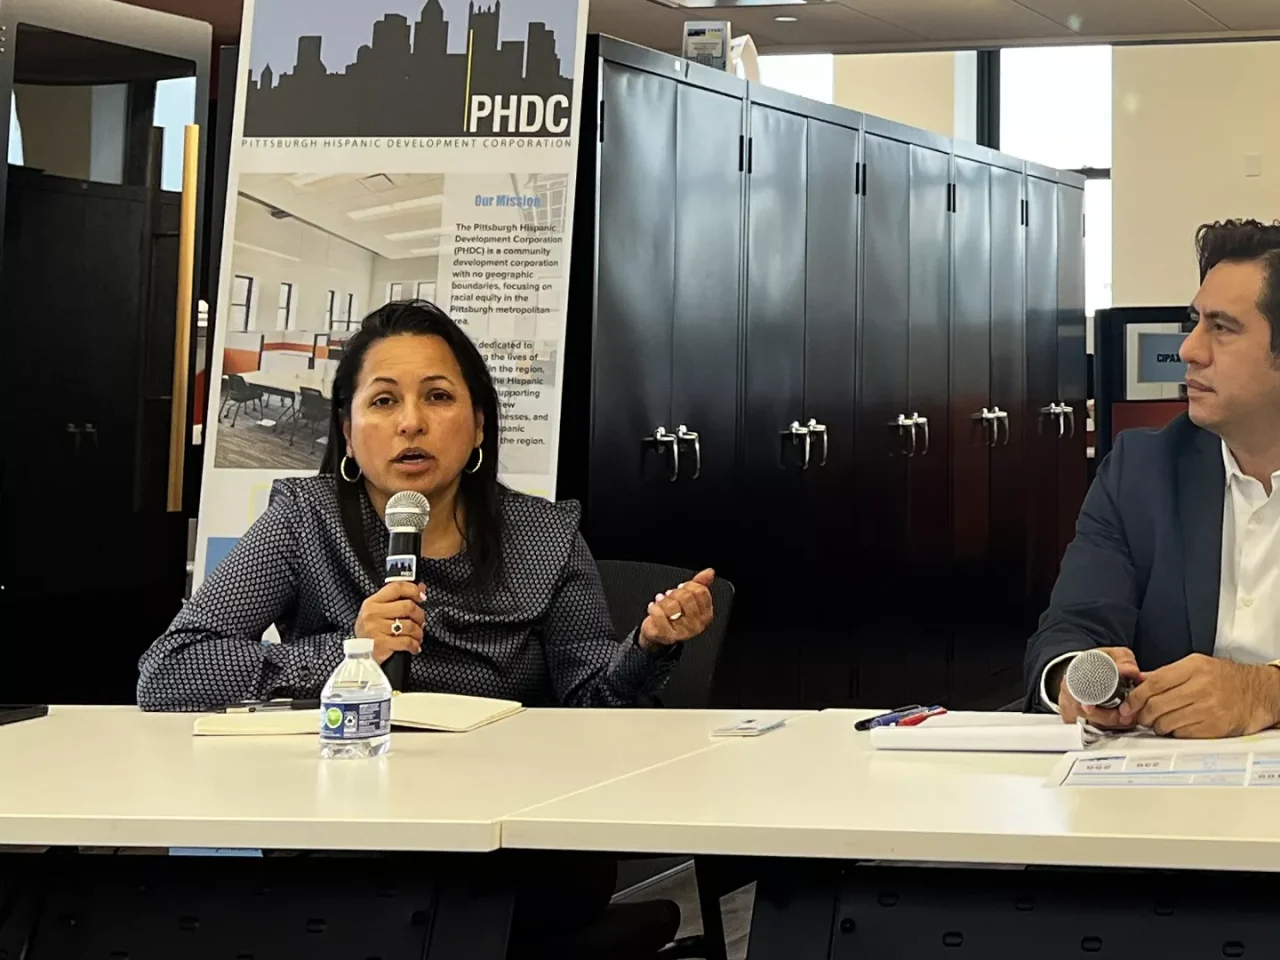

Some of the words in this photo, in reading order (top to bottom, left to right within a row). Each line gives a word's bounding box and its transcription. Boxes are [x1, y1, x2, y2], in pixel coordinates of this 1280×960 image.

[469, 94, 569, 134] PHDC
[241, 139, 318, 149] PITTSBURGH
[323, 139, 381, 149] HISPANIC
[386, 139, 477, 149] DEVELOPMENT
[483, 138, 572, 148] CORPORATION
[474, 194, 494, 207] Our
[496, 194, 541, 208] Mission
[456, 223, 472, 231] The
[473, 223, 518, 233] Pittsburgh
[520, 223, 556, 233] Hispanic
[455, 235, 511, 244] Development
[513, 235, 562, 244] Corporation
[454, 246, 485, 256] (PHDC)
[503, 247, 551, 257] community
[453, 259, 508, 268] development
[510, 259, 559, 268] corporation
[452, 270, 470, 278] with
[485, 270, 534, 280] geographic
[451, 282, 501, 291] boundaries,
[503, 282, 540, 292] focusing
[451, 293, 473, 301] racial
[475, 294, 501, 303] equity
[514, 294, 529, 302] the
[450, 305, 493, 314] Pittsburgh
[495, 305, 550, 314] metropolitan
[478, 341, 521, 349] dedicated
[499, 365, 513, 373] the
[515, 365, 545, 375] region,
[507, 377, 544, 386] Hispanic
[499, 389, 540, 398] upporting
[533, 413, 549, 421] and
[500, 436, 515, 445] the
[516, 437, 546, 446] region.
